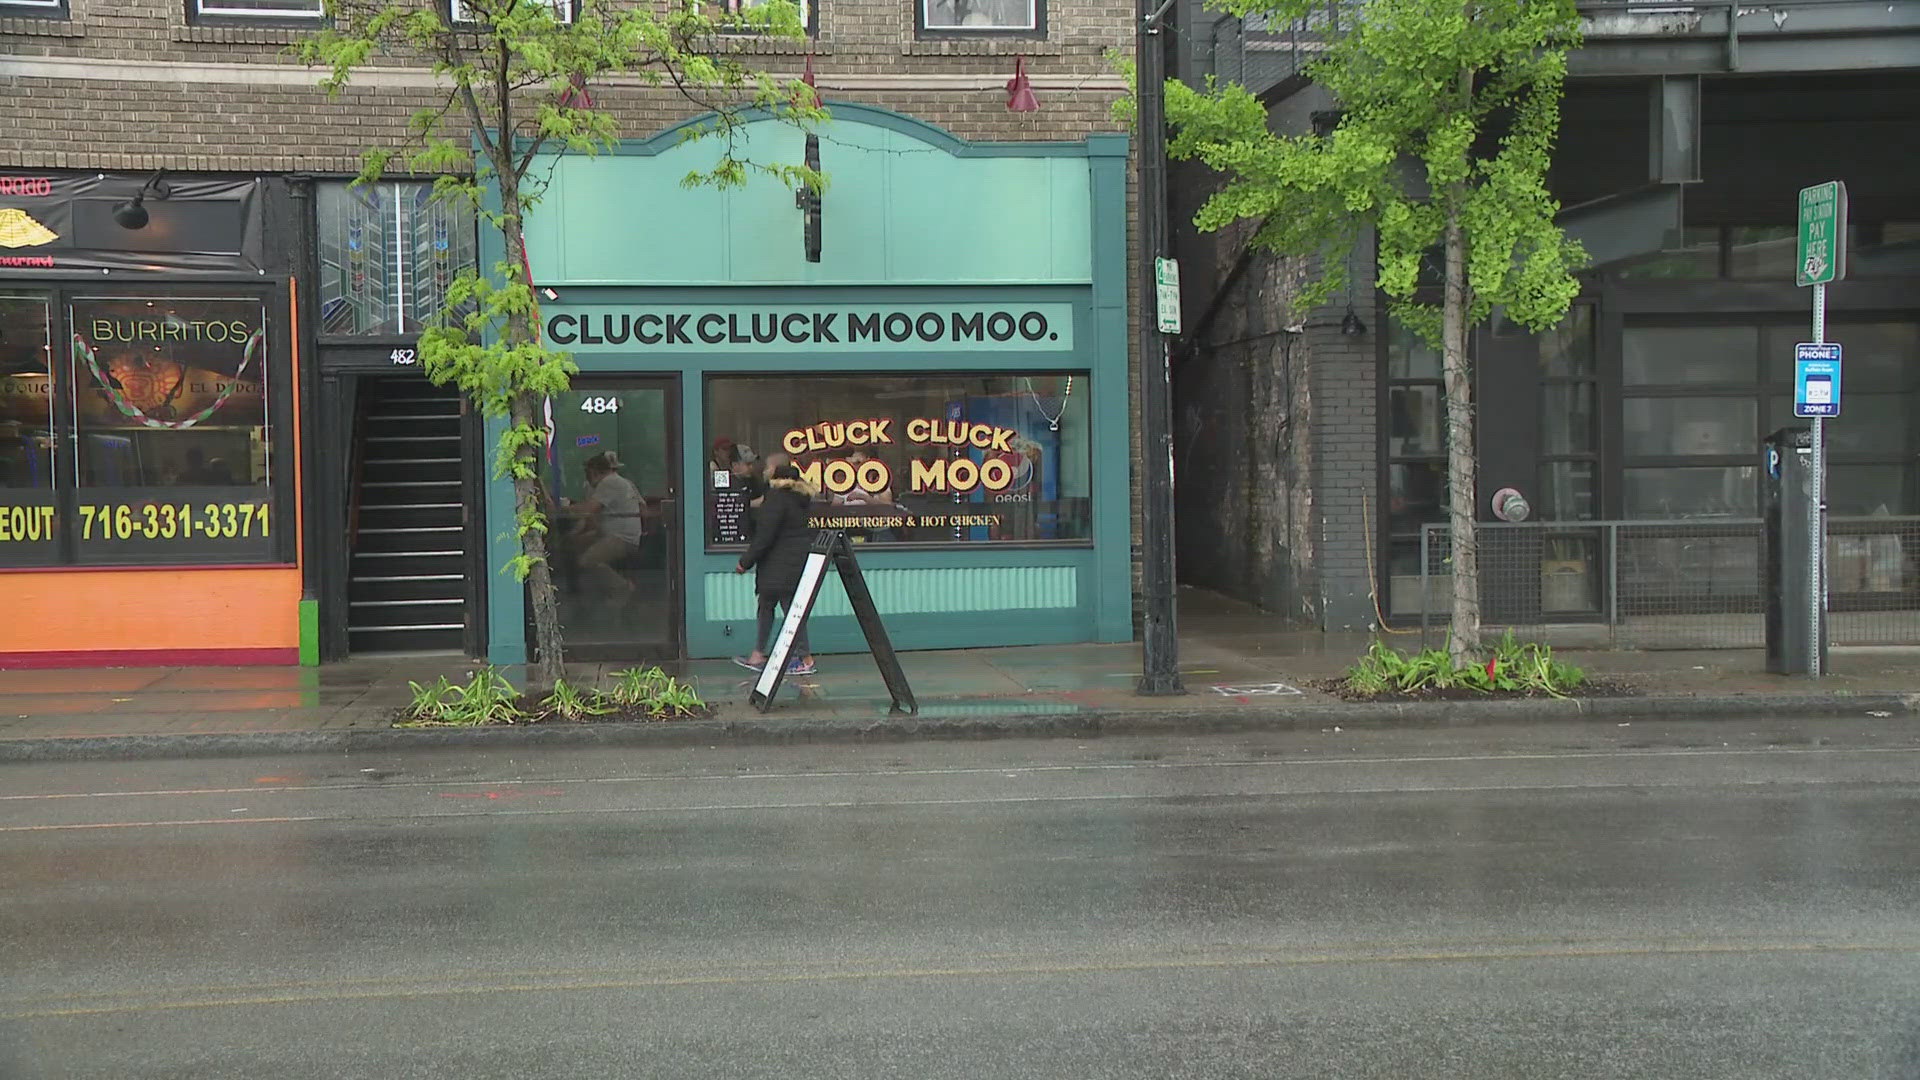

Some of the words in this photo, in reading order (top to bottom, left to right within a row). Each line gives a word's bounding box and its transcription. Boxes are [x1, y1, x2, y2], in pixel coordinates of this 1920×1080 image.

[1803, 184, 1834, 207] PARKING
[1809, 220, 1826, 241] PAY
[1806, 239, 1828, 257] HERE
[92, 319, 249, 344] BURRITOS
[547, 313, 694, 345] CLUCK
[696, 312, 840, 344] CLUCK
[848, 312, 945, 343] MOO
[951, 311, 1058, 342] MOO.
[390, 348, 415, 365] 482
[1799, 350, 1831, 359] PHONE
[581, 396, 618, 414] 484
[1803, 405, 1826, 413] ZONE
[783, 418, 894, 455] CLUCK
[906, 418, 1017, 454] CLUCK
[911, 457, 1014, 494] MOO
[79, 503, 270, 540] 716-331-3371
[906, 516, 917, 528] &
[920, 515, 947, 527] HOT
[950, 514, 1001, 527] CHICKEN
